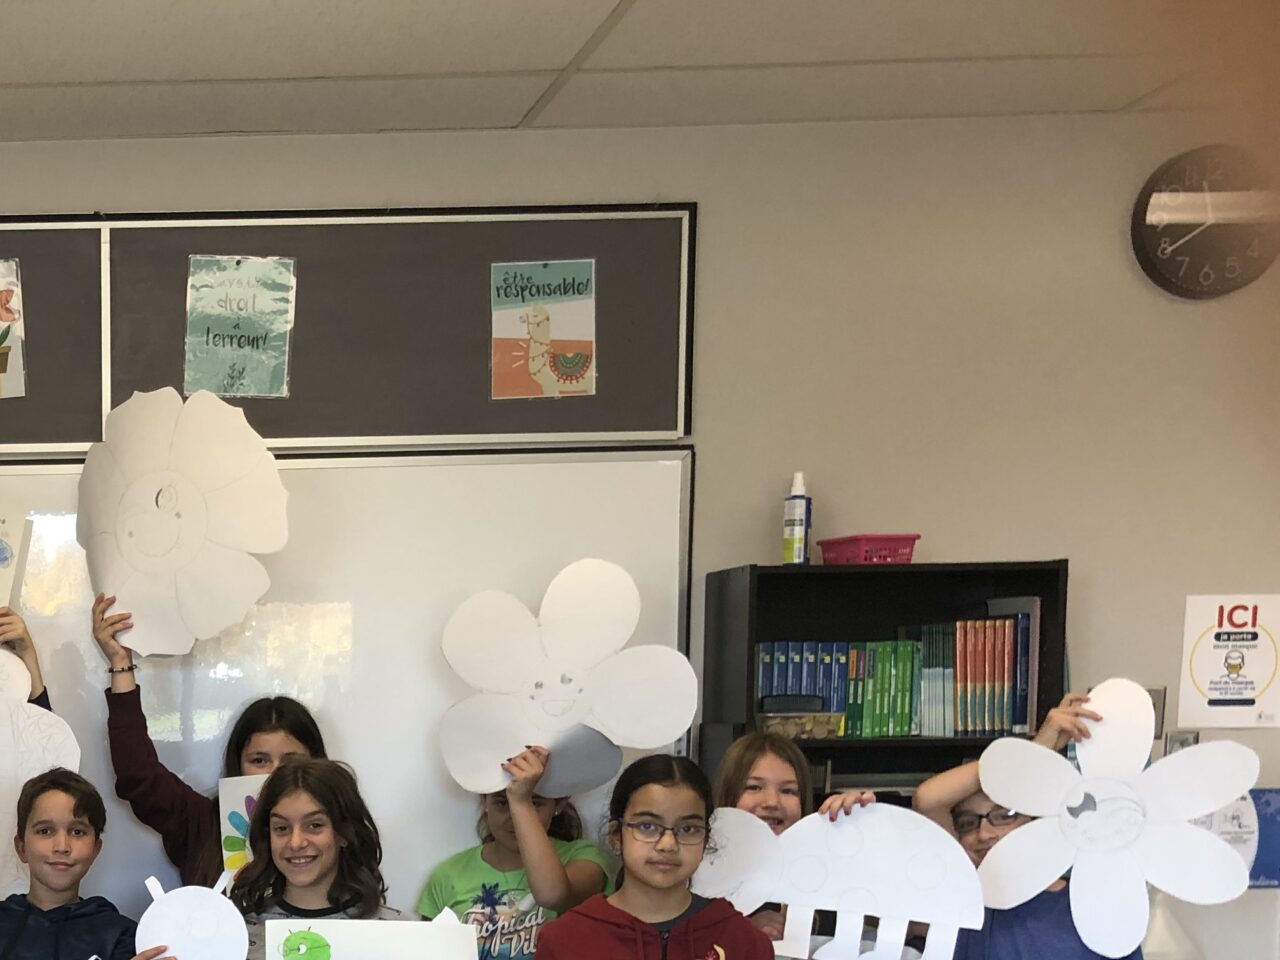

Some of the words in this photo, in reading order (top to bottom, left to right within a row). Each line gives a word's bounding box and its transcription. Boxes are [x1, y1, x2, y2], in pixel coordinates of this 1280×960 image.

[1157, 237, 1171, 259] 8
[1176, 256, 1190, 278] 7
[1199, 264, 1215, 285] 6
[1225, 256, 1241, 278] 5
[496, 276, 590, 303] responsable!
[502, 271, 534, 286] être
[1217, 604, 1258, 629] ICI
